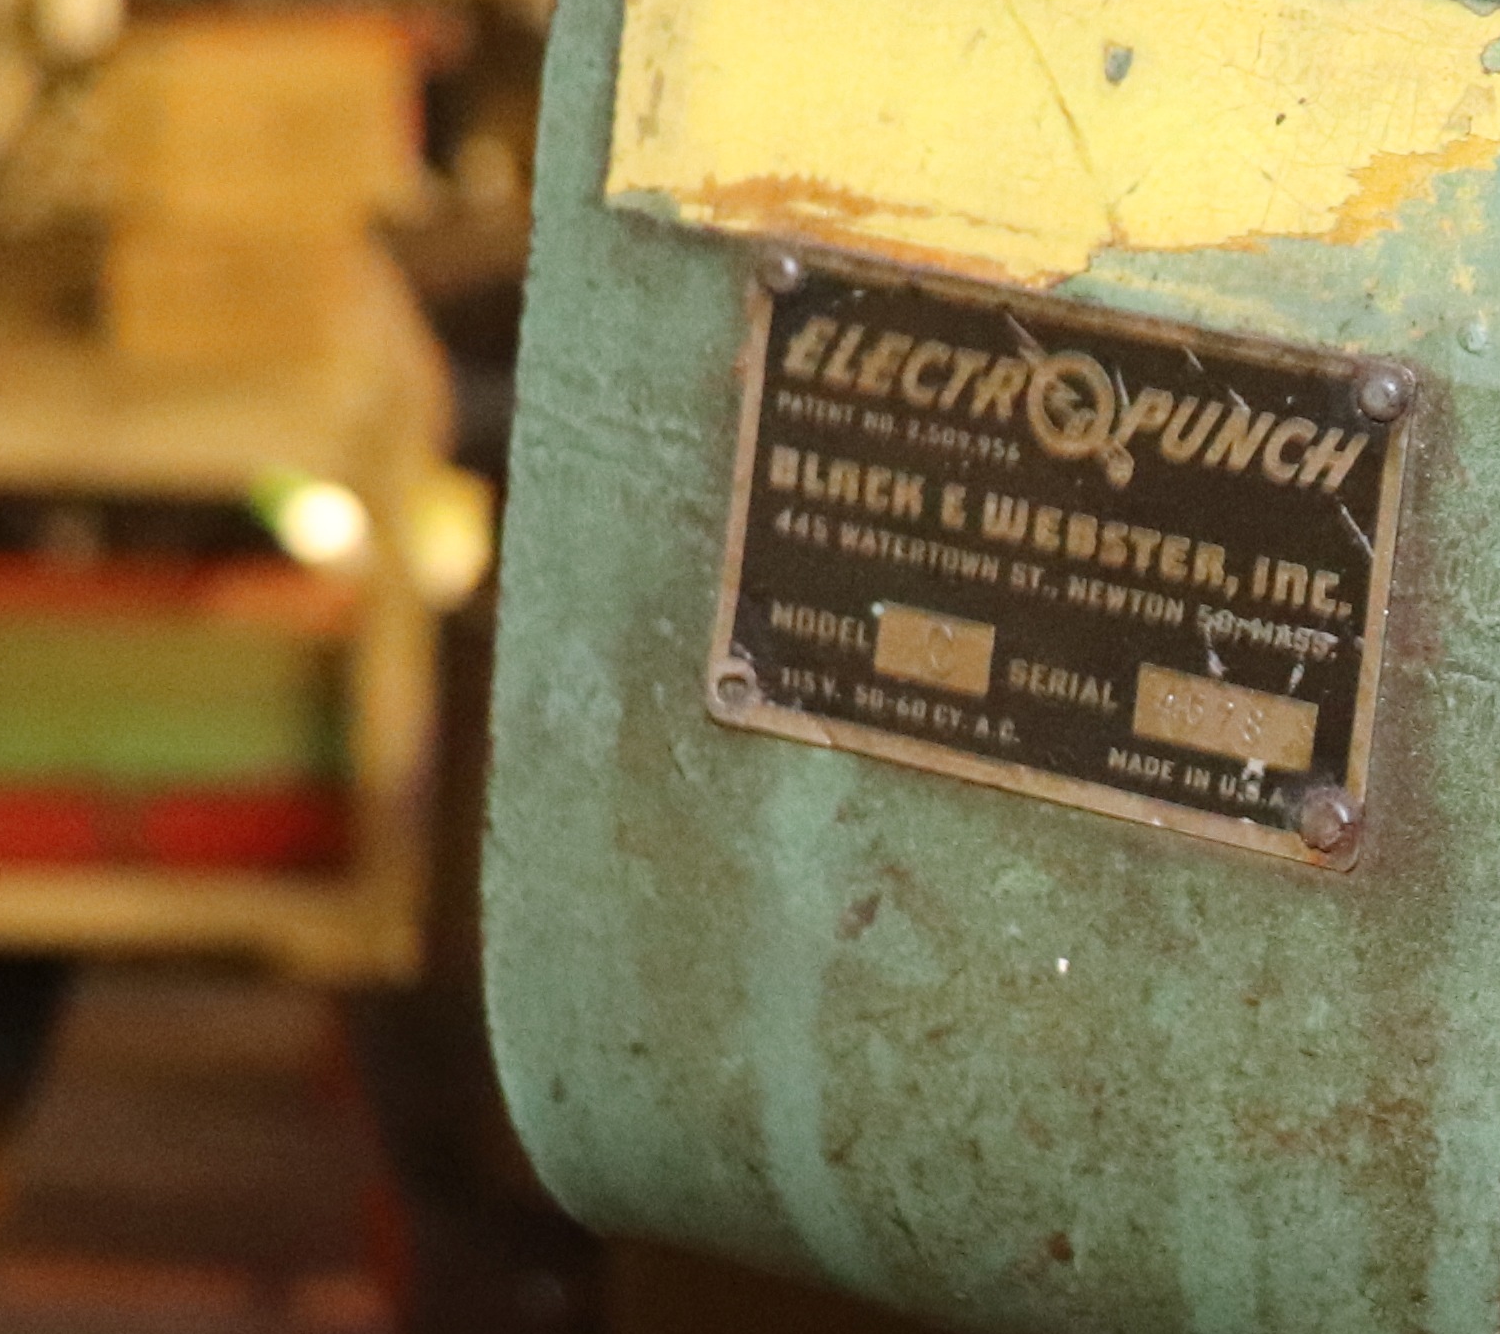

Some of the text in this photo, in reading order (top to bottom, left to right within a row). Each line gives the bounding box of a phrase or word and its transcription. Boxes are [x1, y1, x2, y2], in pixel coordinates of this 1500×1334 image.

[776, 389, 854, 425] PATENT
[1112, 385, 1371, 495] PUNCH
[768, 444, 926, 519] BLACK
[981, 490, 1240, 601] WEBSTER,
[775, 508, 828, 547] 445
[839, 521, 999, 584] WATERTOWN
[1066, 574, 1185, 628] NEWTON
[1248, 616, 1338, 660] MASS.
[769, 598, 871, 651] MODEL
[780, 666, 817, 696] 115
[854, 682, 928, 722] 50-60
[1009, 657, 1119, 711] SERIAL
[1106, 746, 1176, 783] MADE
[1184, 765, 1212, 794] IN
